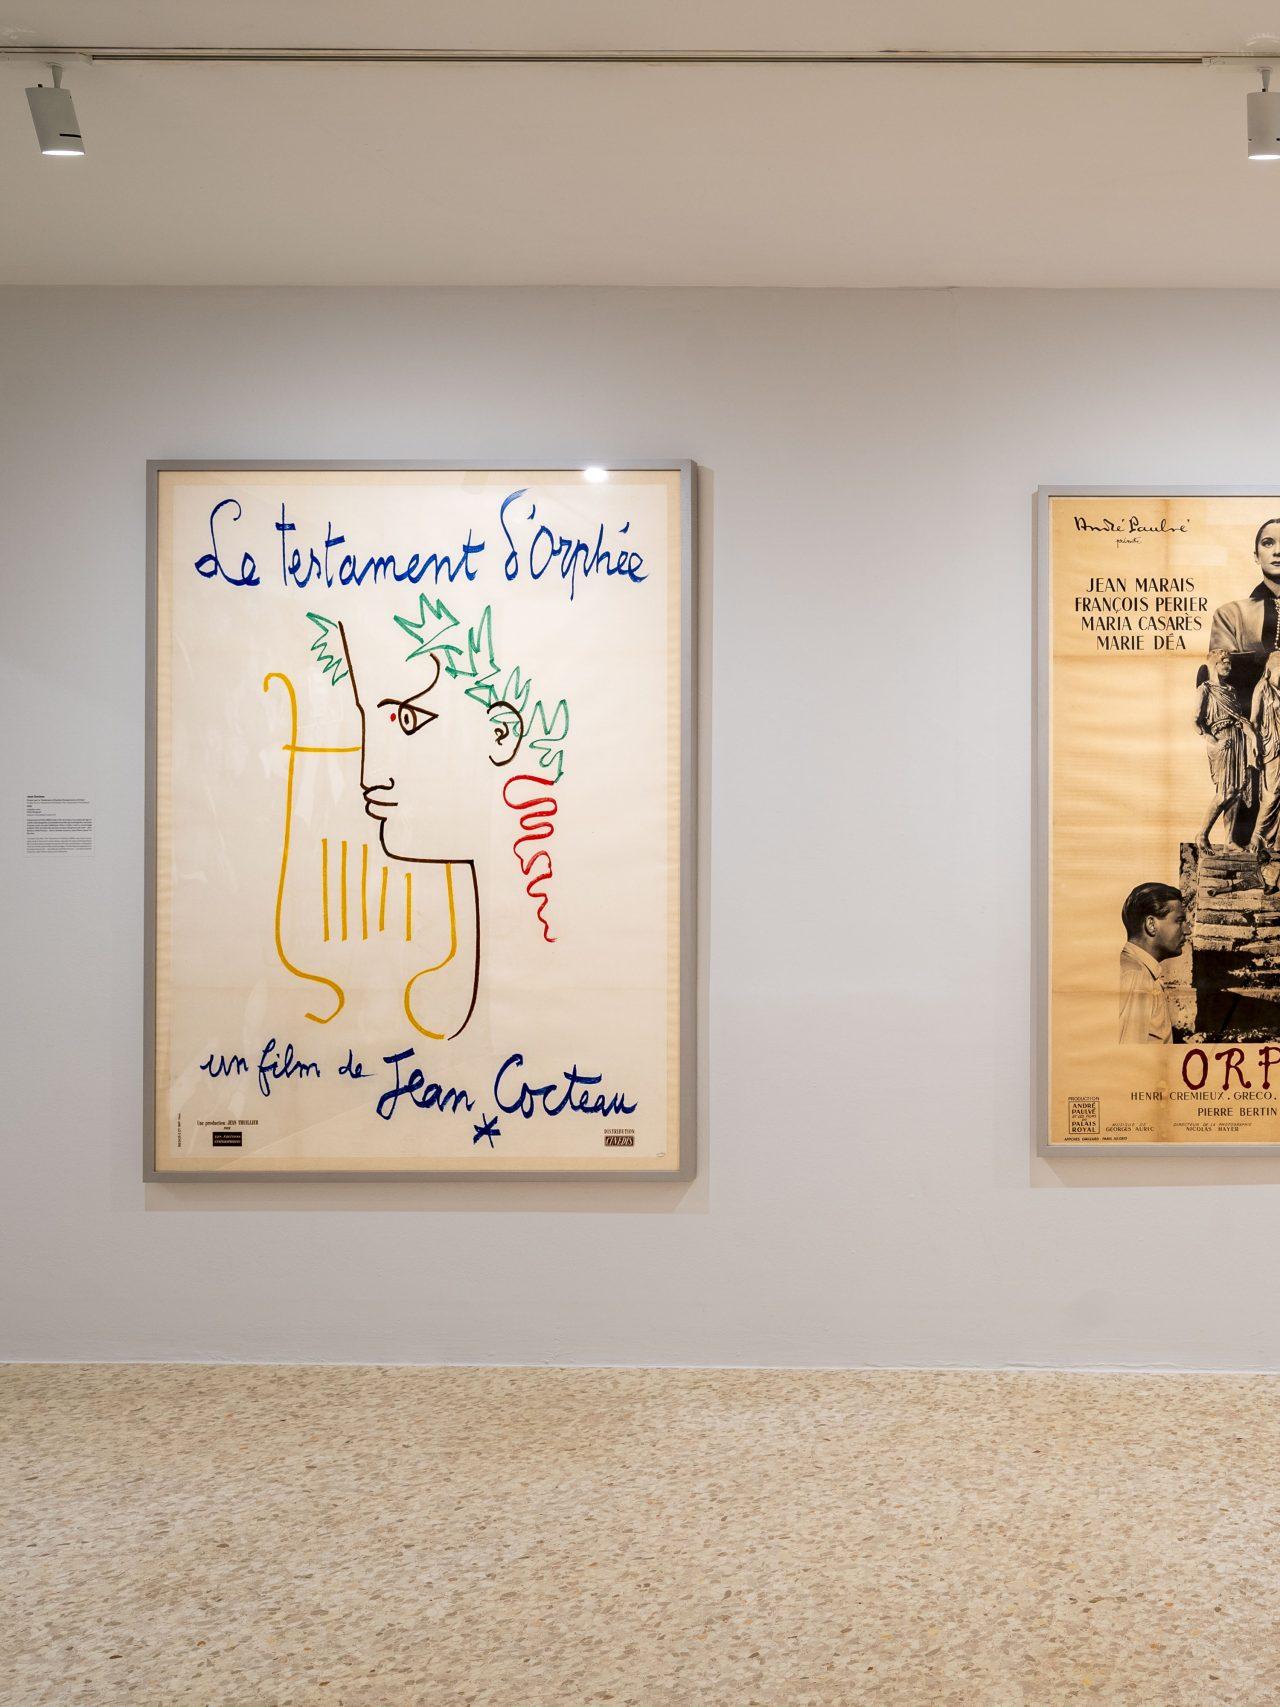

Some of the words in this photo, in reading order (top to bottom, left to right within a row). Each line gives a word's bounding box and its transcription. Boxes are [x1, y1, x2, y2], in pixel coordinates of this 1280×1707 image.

[1074, 516, 1125, 531] André
[194, 498, 260, 586] Le
[276, 503, 485, 587] testament
[1086, 578, 1127, 592] JEAN
[1135, 578, 1195, 592] MARAIS
[1075, 597, 1149, 613] FRANÇOIS
[1156, 597, 1208, 612] PERIER
[1082, 616, 1132, 631] MARIA
[1138, 613, 1202, 631] CASARÈS
[1097, 635, 1144, 650] MARIE
[1154, 633, 1186, 650] DÉA
[200, 1053, 249, 1076] un
[258, 1038, 321, 1096] film
[338, 1048, 375, 1078] de
[376, 1047, 476, 1120] Jean
[494, 1053, 637, 1114] Cocteau
[1131, 1092, 1163, 1100] HENRI
[1198, 1107, 1233, 1117] PIERRE
[1240, 1107, 1277, 1116] BERTIN
